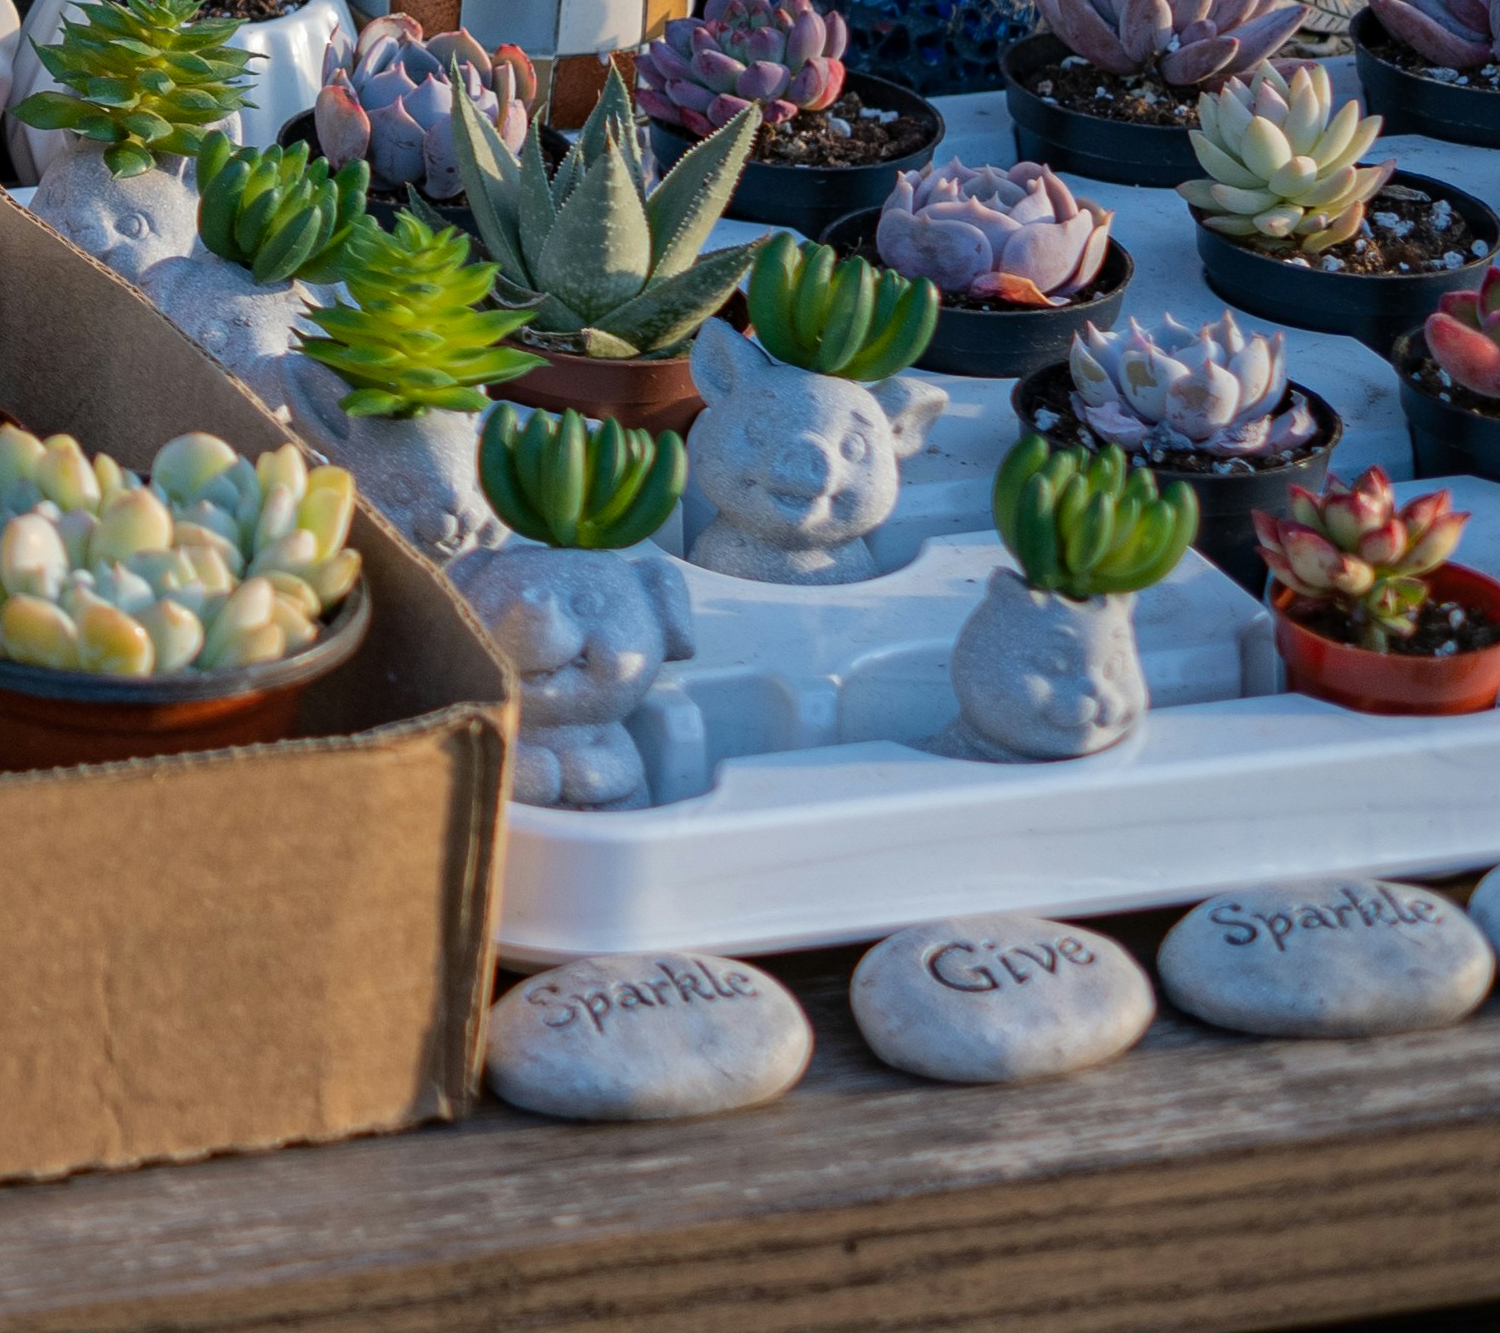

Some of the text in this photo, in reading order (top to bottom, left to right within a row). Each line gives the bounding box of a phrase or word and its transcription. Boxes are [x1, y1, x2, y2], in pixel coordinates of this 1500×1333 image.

[1209, 884, 1444, 953] Sparkle
[523, 957, 759, 1034] Sparkle
[924, 935, 1097, 994] Give
